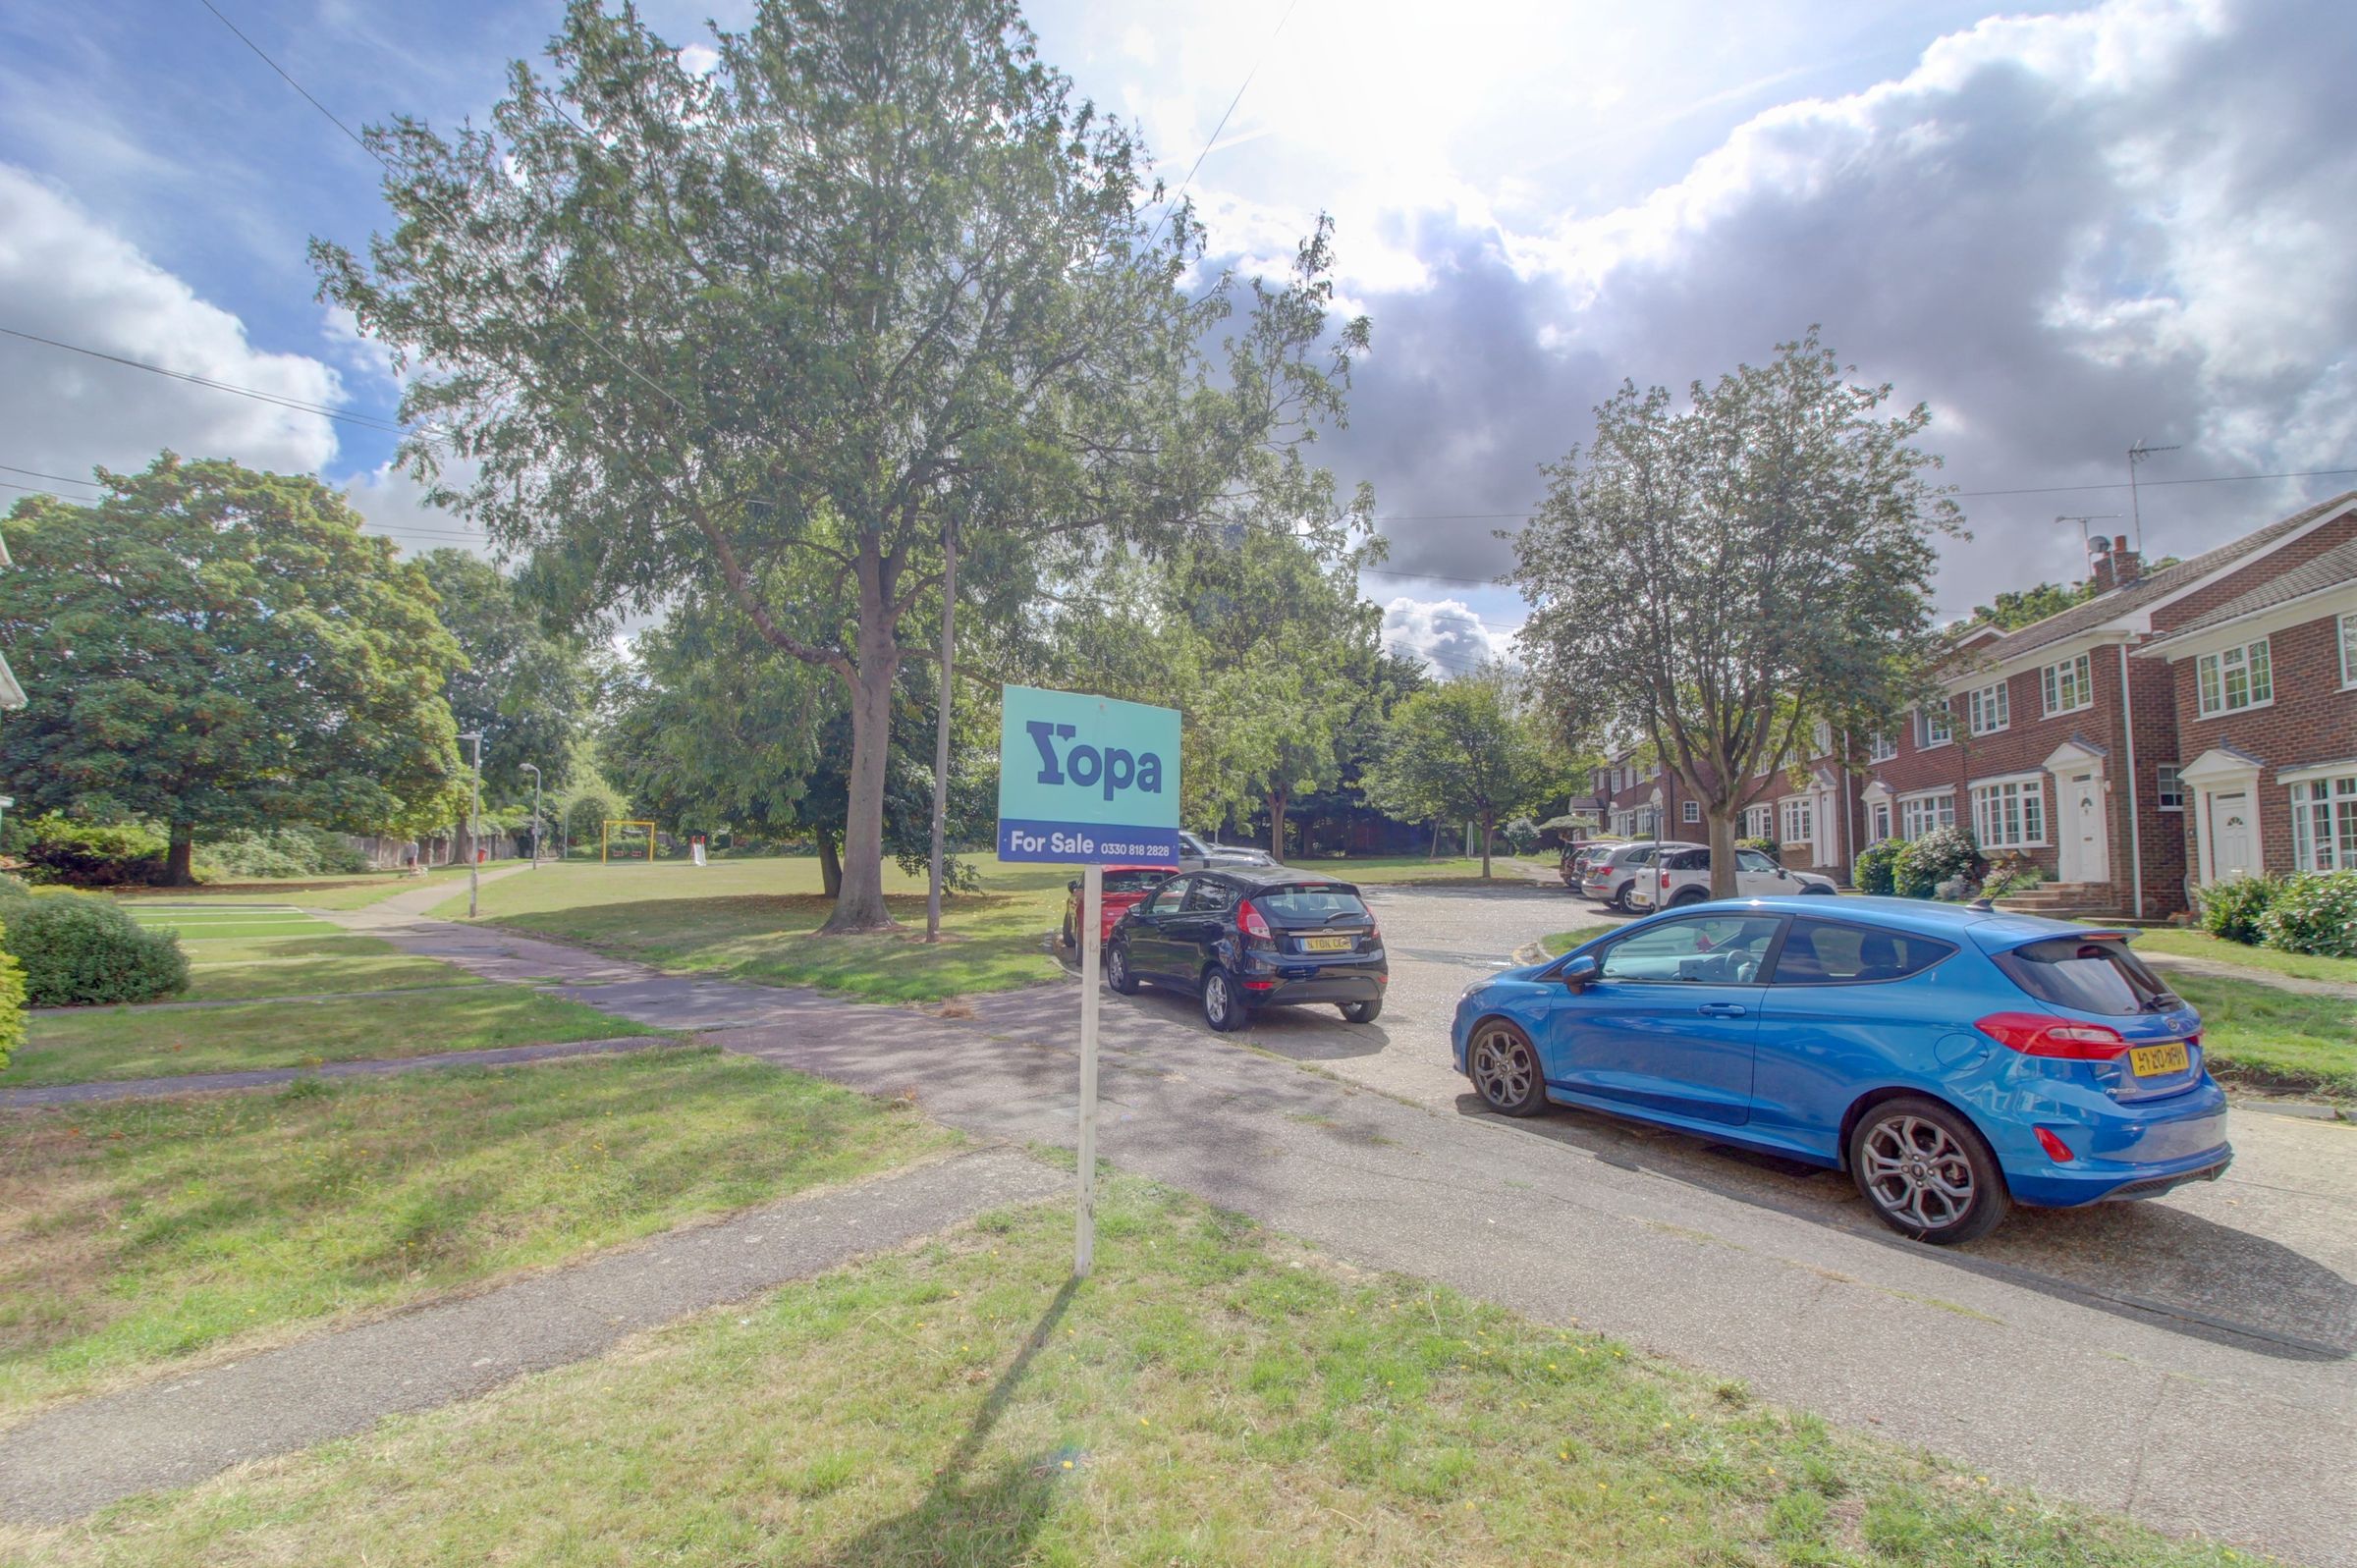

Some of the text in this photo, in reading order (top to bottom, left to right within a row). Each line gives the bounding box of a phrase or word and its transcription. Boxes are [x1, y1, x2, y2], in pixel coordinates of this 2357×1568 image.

[1026, 720, 1162, 801] Yopa
[1011, 831, 1094, 853] For Sale
[1100, 842, 1170, 857] 0330 818 2828
